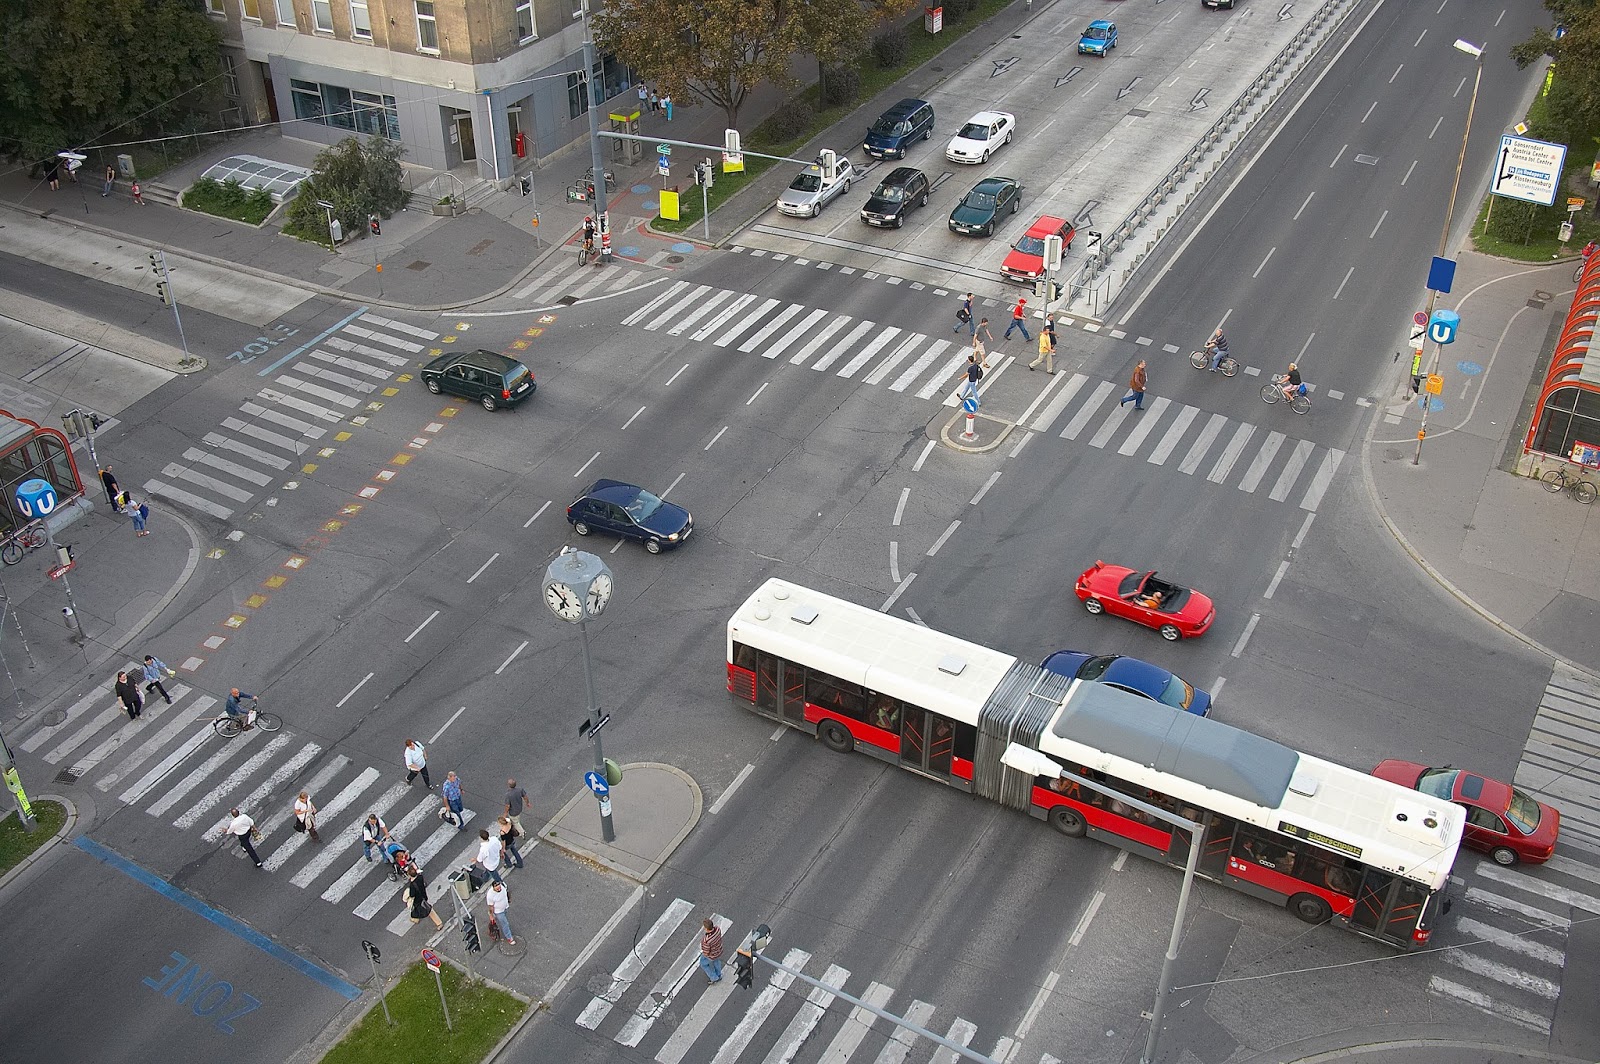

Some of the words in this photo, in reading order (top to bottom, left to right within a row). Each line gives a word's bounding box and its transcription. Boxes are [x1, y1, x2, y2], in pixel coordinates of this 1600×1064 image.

[1511, 153, 1527, 161] Vienna
[1513, 147, 1531, 156] Austria
[1532, 150, 1549, 159] Center
[1433, 324, 1451, 343] U
[17, 497, 33, 517] U
[37, 492, 54, 515] U
[142, 950, 262, 1035] ZONE
